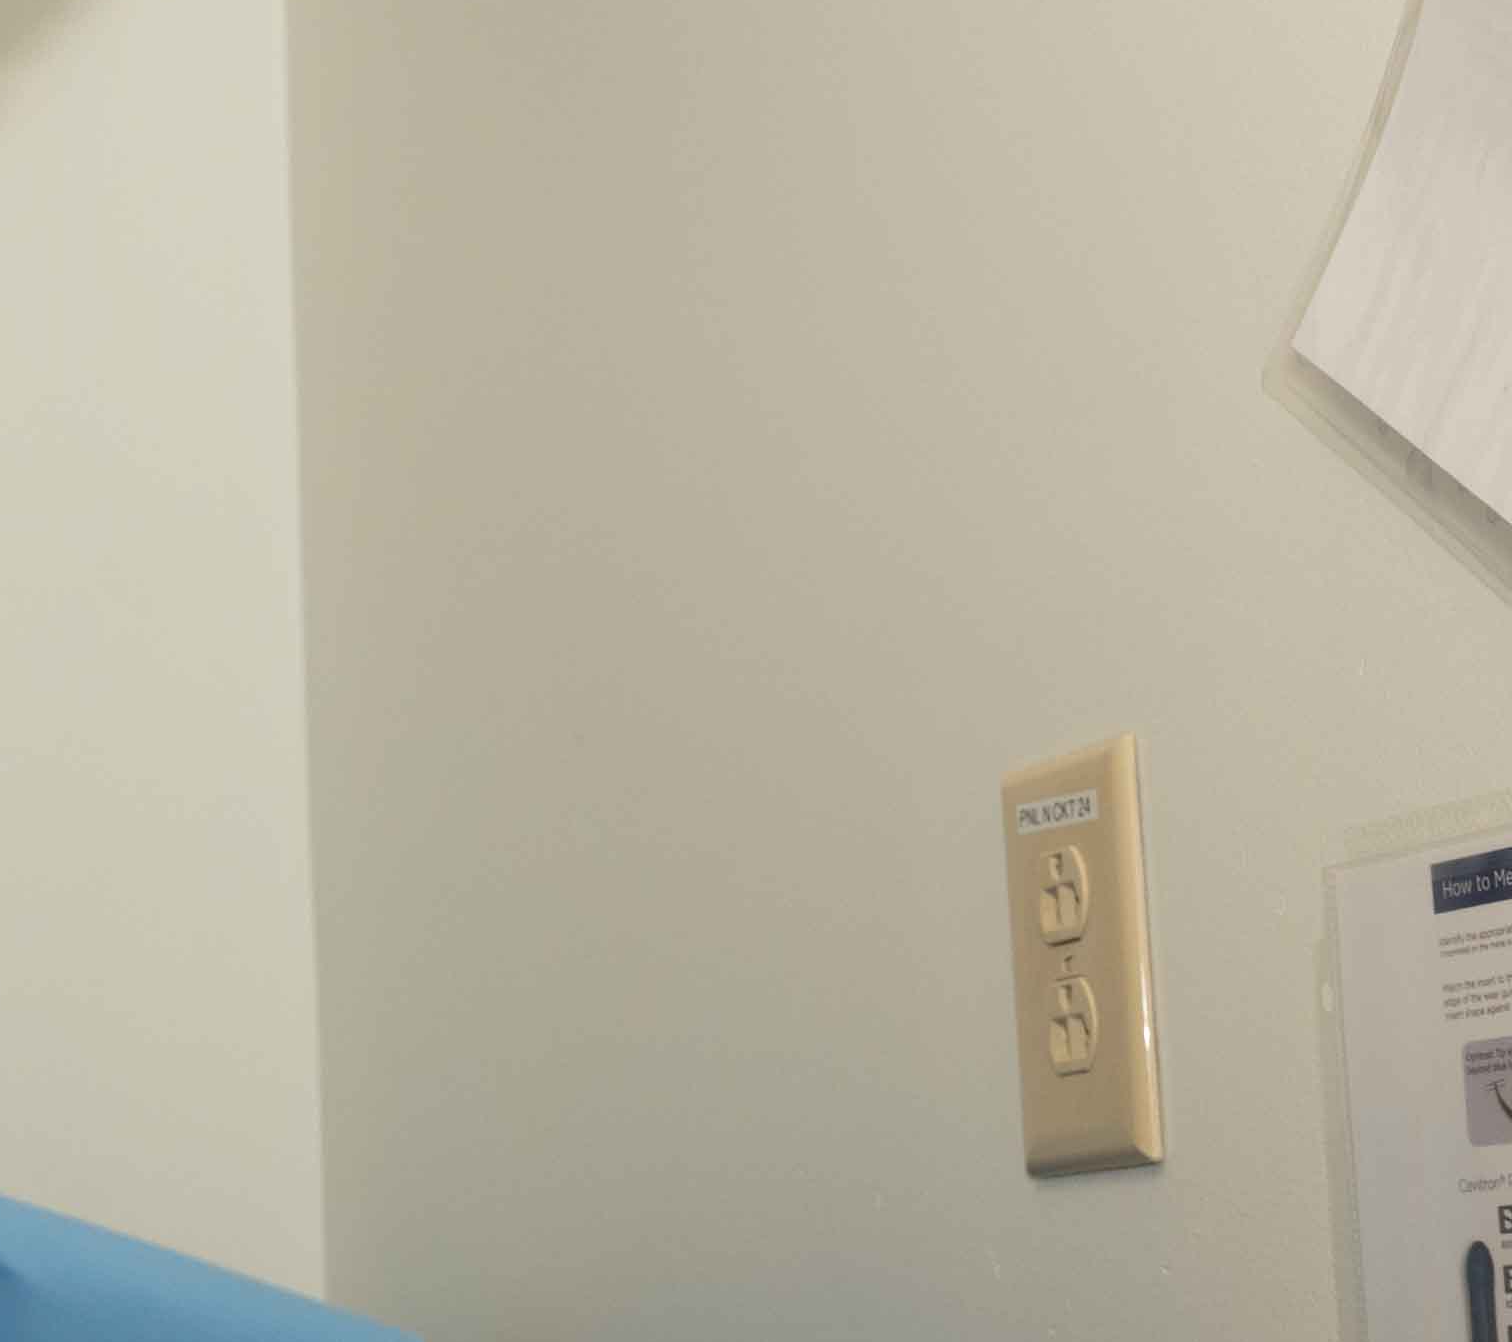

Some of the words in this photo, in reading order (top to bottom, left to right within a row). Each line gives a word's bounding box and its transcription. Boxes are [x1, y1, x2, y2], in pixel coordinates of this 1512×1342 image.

[1077, 796, 1091, 818] 24
[1443, 876, 1471, 899] How
[1477, 876, 1490, 891] to
